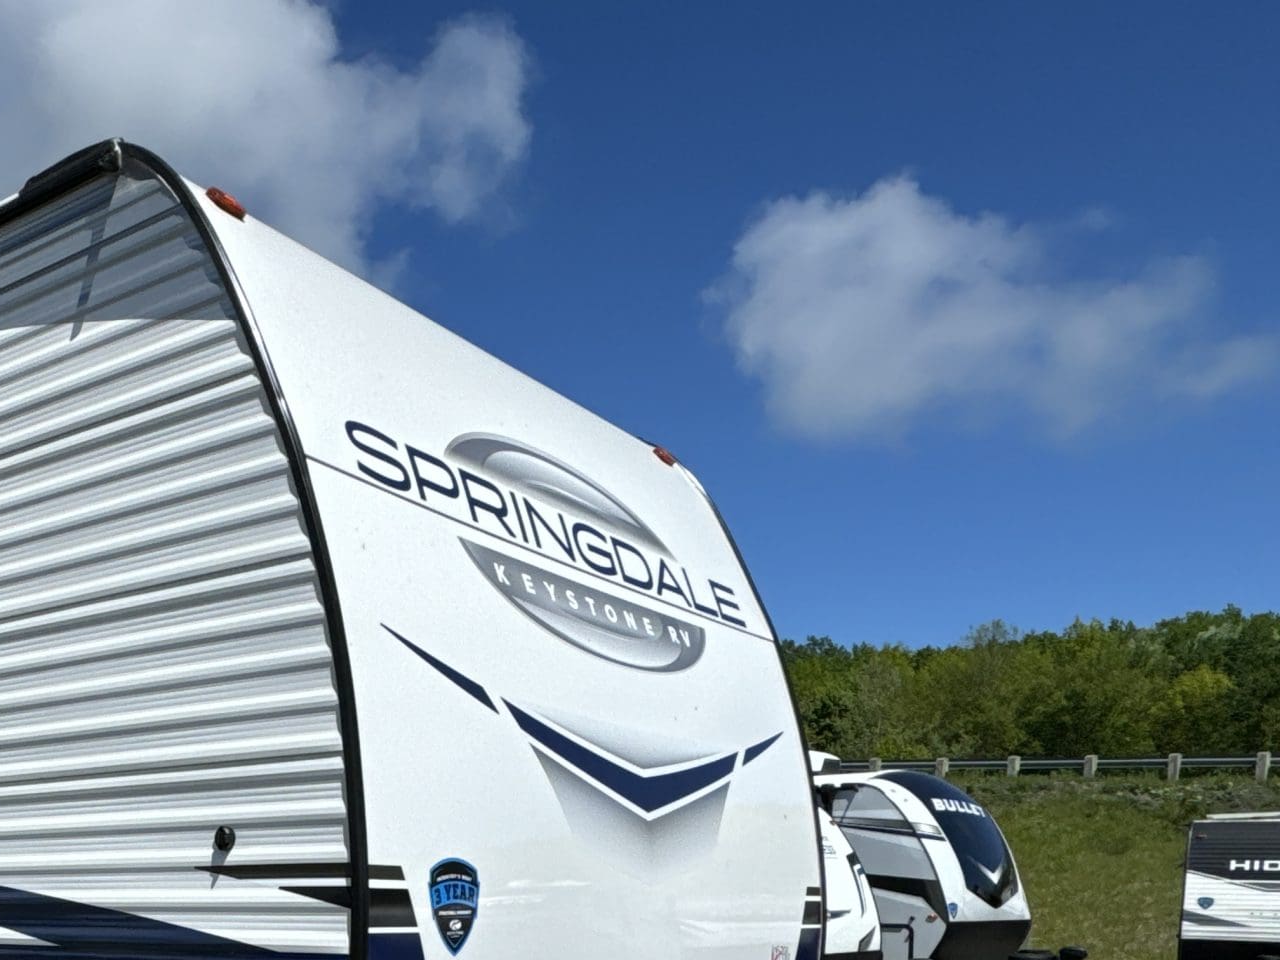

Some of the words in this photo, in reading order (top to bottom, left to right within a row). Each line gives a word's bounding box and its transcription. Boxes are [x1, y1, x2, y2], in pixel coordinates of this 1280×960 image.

[344, 420, 747, 628] SPRINGDALE
[493, 562, 654, 637] KEYSTONE
[668, 625, 691, 648] RV
[931, 798, 986, 817] BULLET
[433, 887, 442, 905] 3
[443, 883, 475, 903] YEAR
